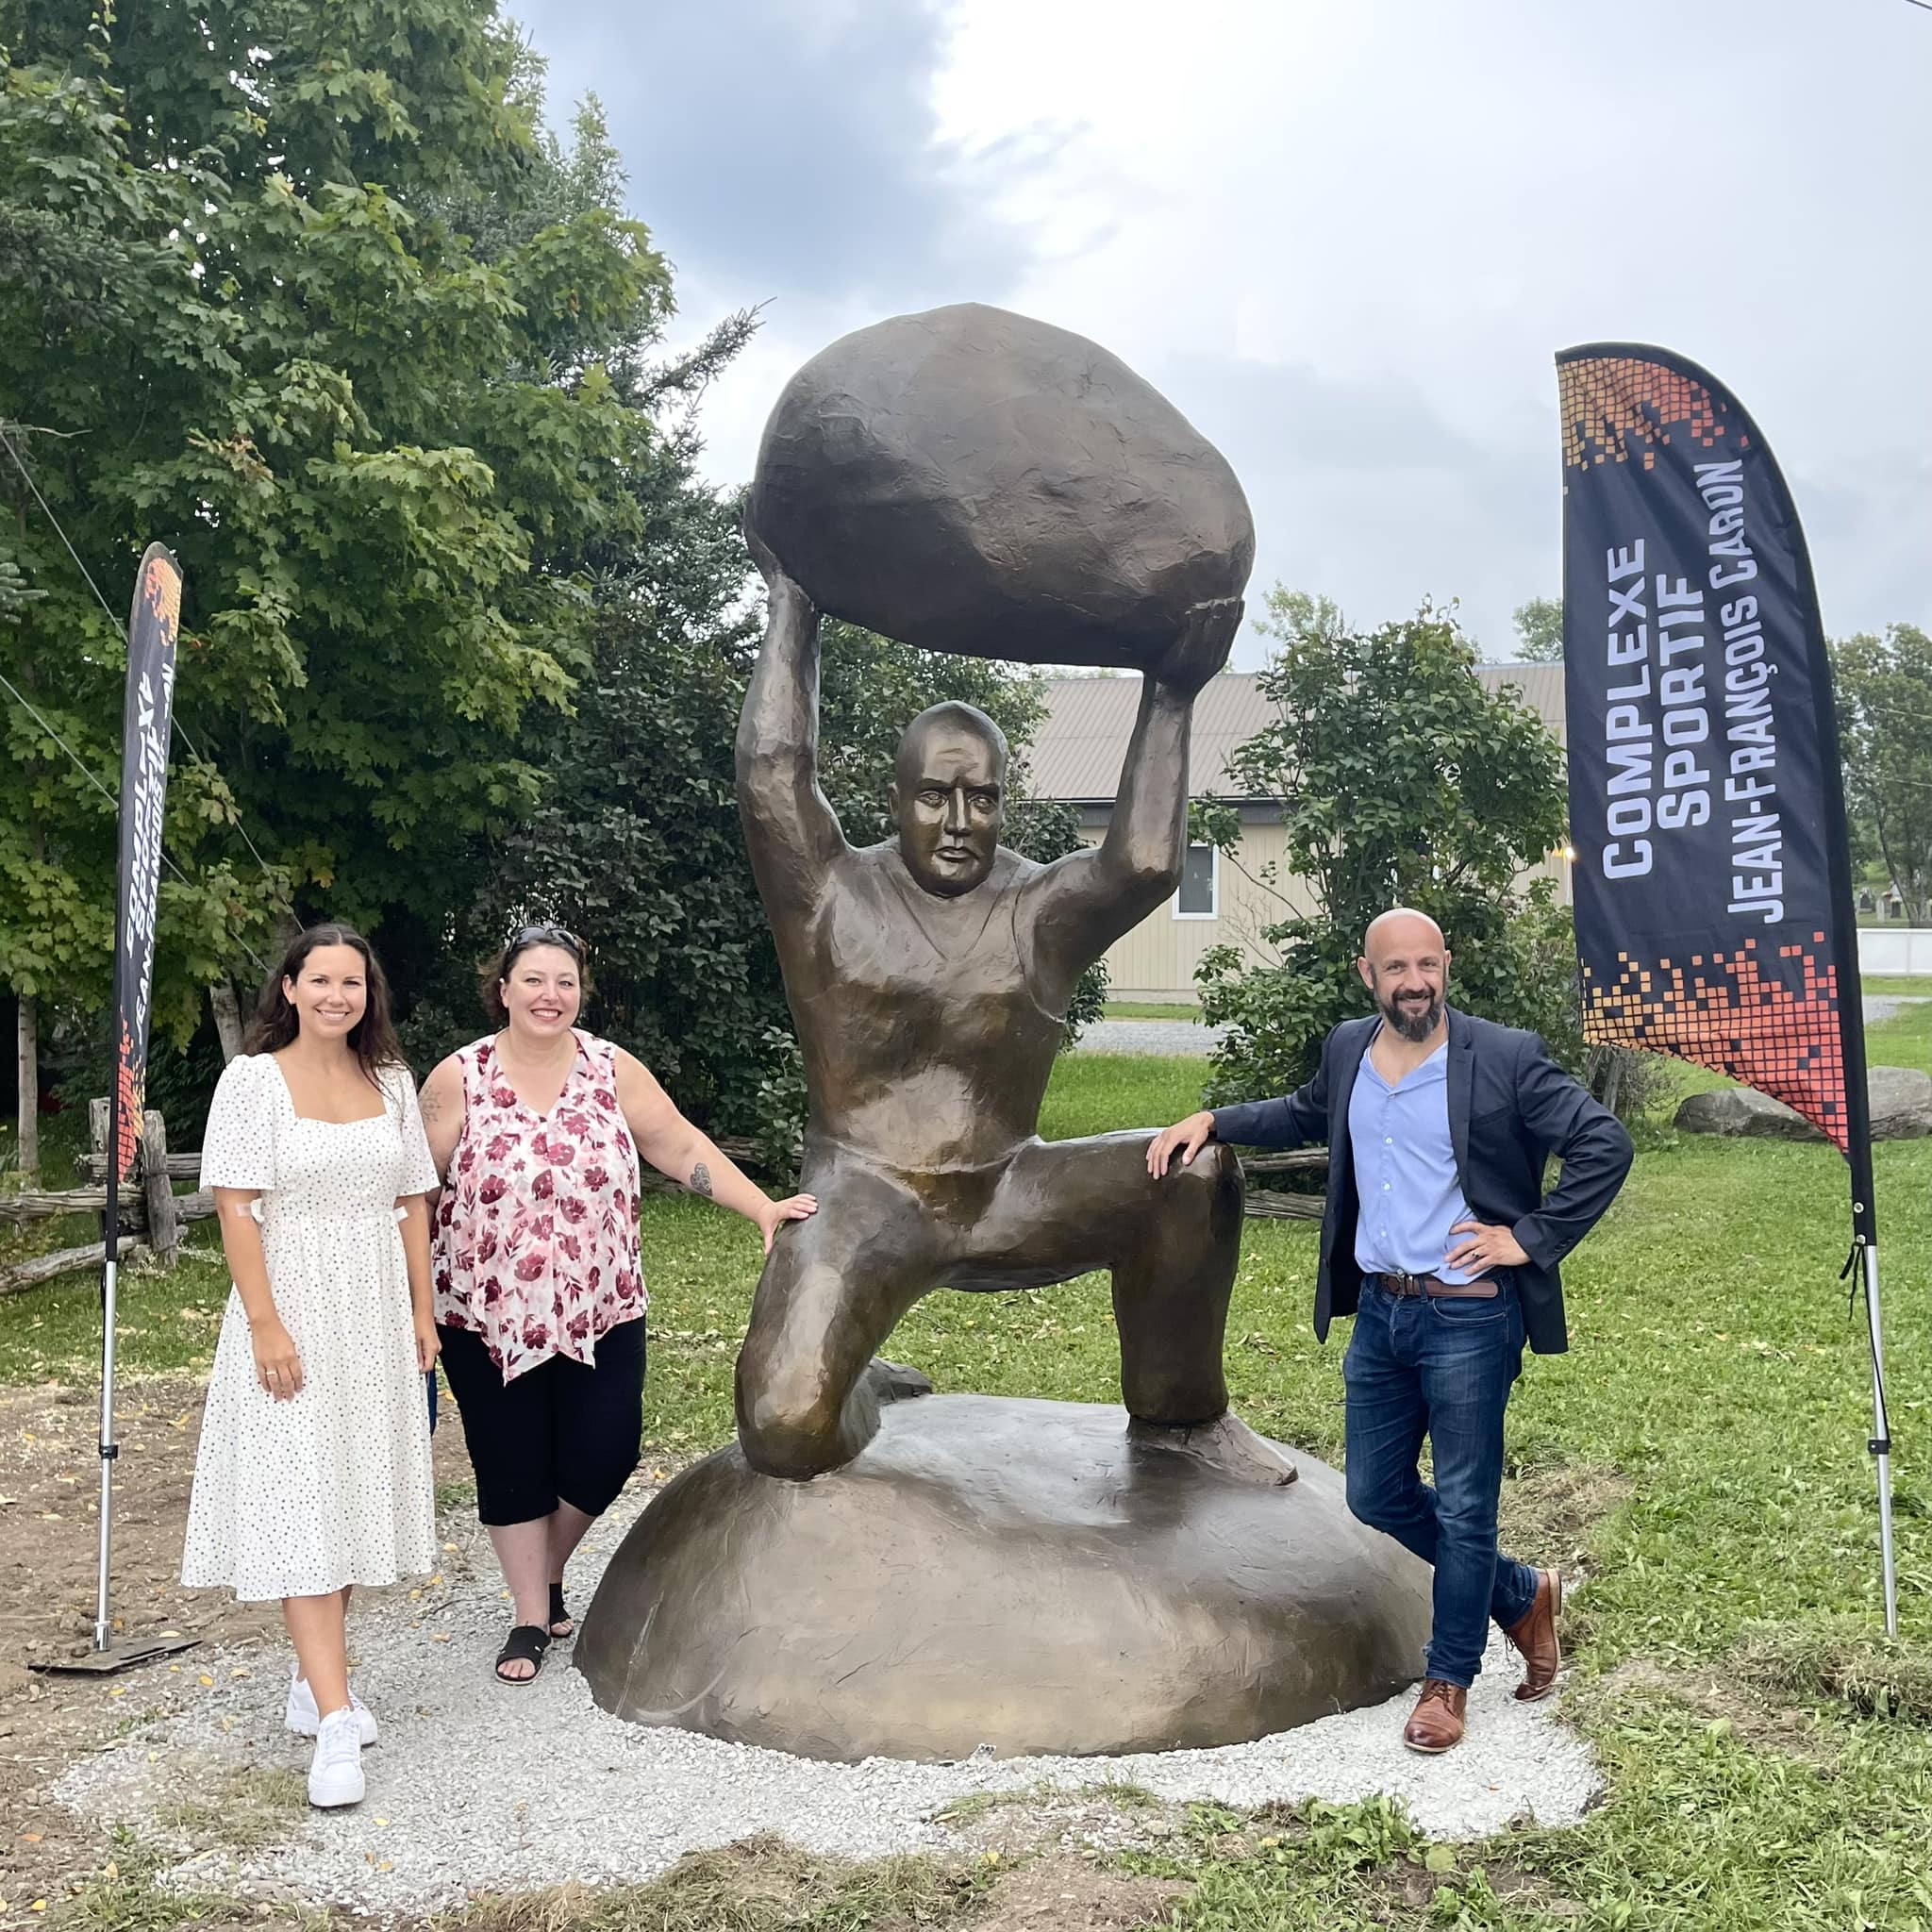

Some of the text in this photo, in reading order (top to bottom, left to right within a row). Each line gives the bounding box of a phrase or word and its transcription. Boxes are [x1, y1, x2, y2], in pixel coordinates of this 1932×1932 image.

[1603, 539, 1653, 879] COMPLEXE
[1656, 574, 1710, 829] SPORTIF
[1693, 458, 1784, 924] JEAN-FRANÇOIS CARON
